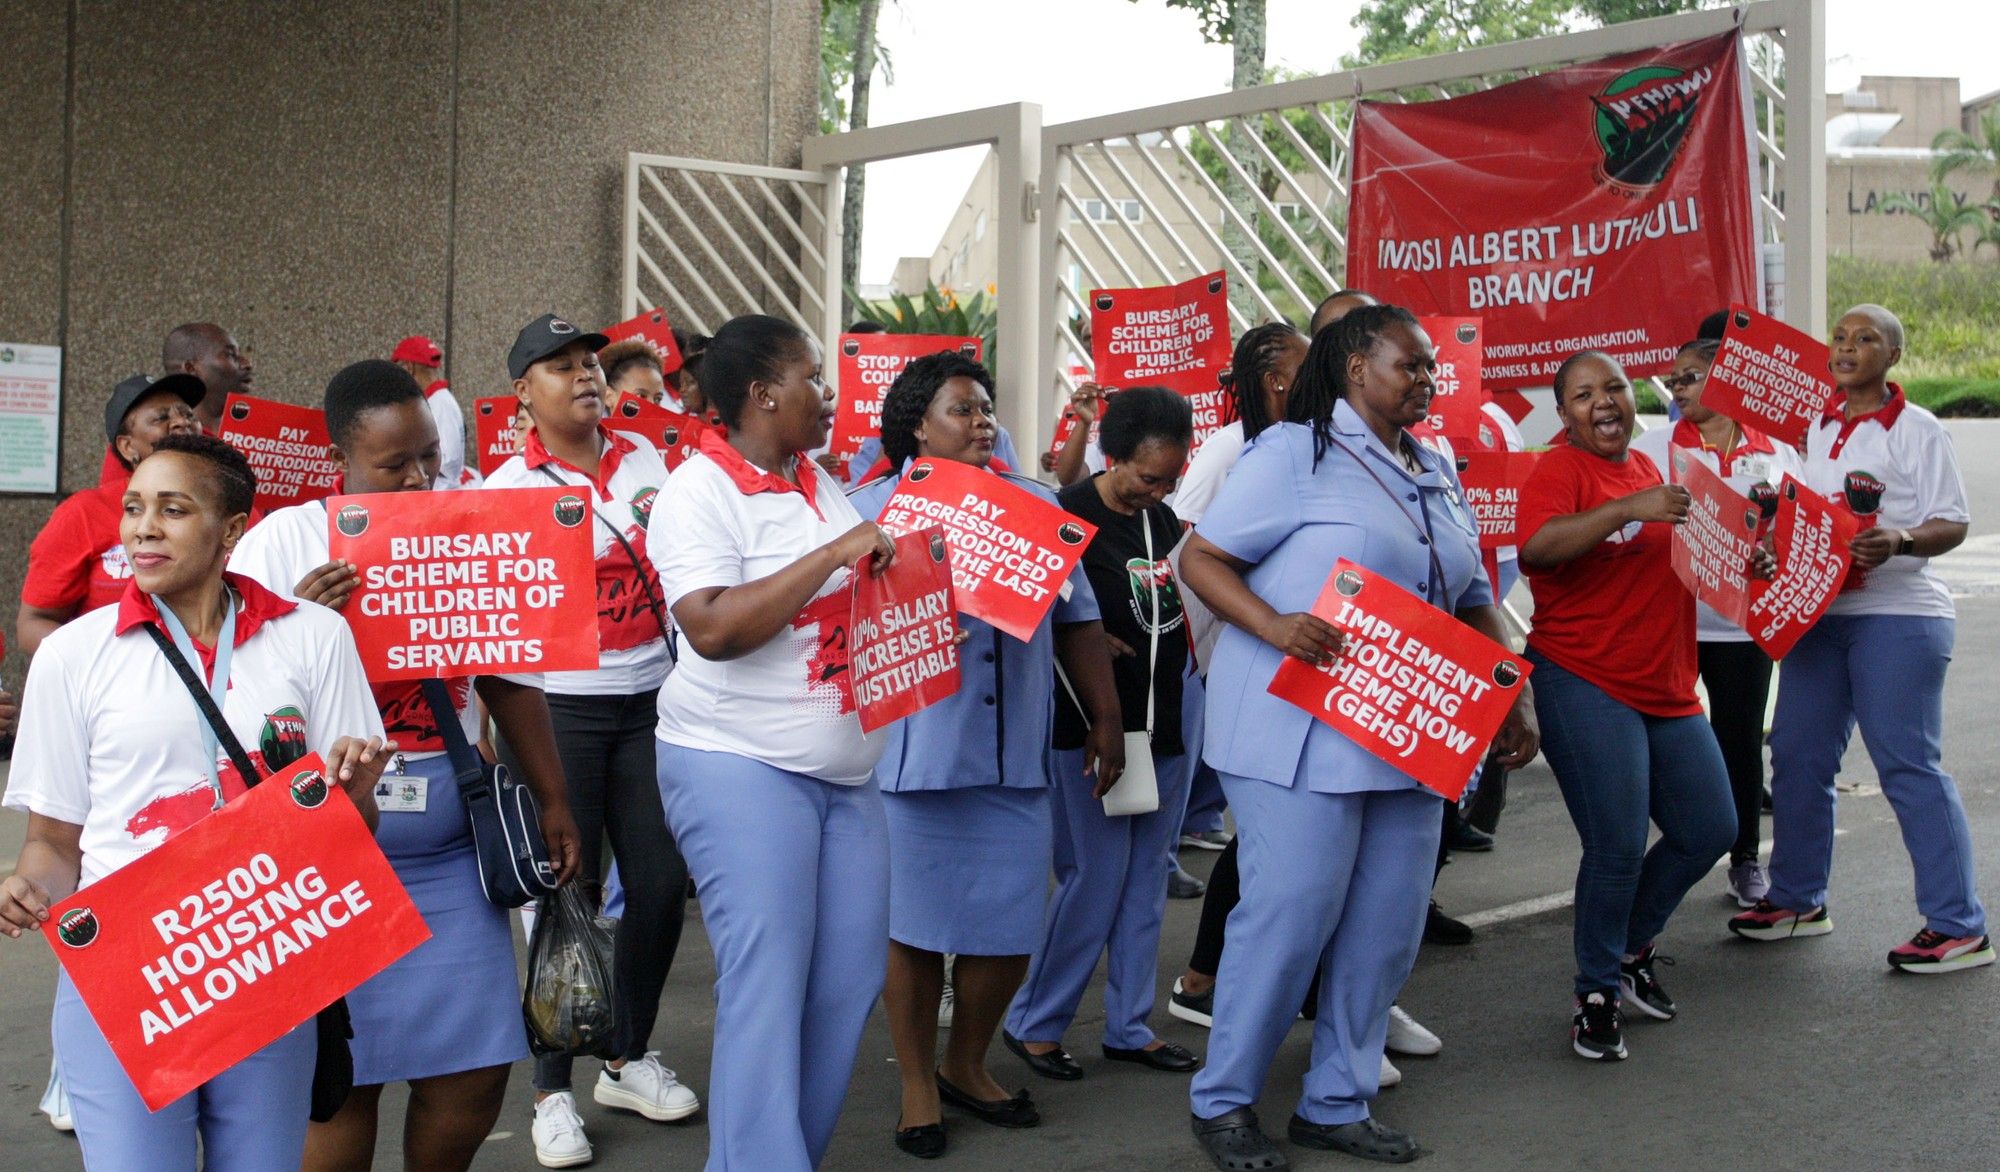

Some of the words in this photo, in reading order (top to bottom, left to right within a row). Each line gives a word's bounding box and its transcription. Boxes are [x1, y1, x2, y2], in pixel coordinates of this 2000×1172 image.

[1609, 65, 1712, 119] NEHAWU
[1449, 226, 1560, 268] ALBERT
[1571, 197, 1698, 257] LUTHULI
[1468, 266, 1594, 308] BRANCH
[1112, 323, 1179, 340] SCHEME
[1183, 313, 1210, 332] FOR
[1125, 302, 1198, 325] BURSARY
[1109, 333, 1191, 354] CHILDREN
[1195, 326, 1214, 342] OF
[1136, 347, 1193, 368] PUBLIC
[1485, 341, 1552, 359] WORKPLACE
[1554, 328, 1649, 353] ORGANISATION,
[1773, 344, 1800, 365] PAY
[857, 355, 900, 369] STOP
[1481, 363, 1528, 379] OUSNESS
[1531, 362, 1540, 376] &
[1724, 337, 1816, 391] PROGRESSION
[1818, 381, 1831, 398] TO
[1436, 380, 1459, 396] OF
[1712, 365, 1766, 398] BEYOND
[1769, 391, 1795, 412] THE
[1723, 353, 1742, 371] BE
[1743, 362, 1825, 411] INTRODUCED
[1741, 394, 1788, 424] NOTCH
[223, 431, 327, 459] PROGRESSION
[279, 426, 309, 442] PAY
[247, 451, 337, 473] INTRODUCED
[279, 470, 305, 485] THE
[961, 493, 1006, 521] PAY
[1466, 487, 1491, 503] 0%
[1704, 493, 1720, 519] PAY
[883, 509, 911, 526] BE
[888, 493, 1033, 556] PROGRESSION
[1036, 546, 1064, 571] TO
[1689, 500, 1734, 545] OGRESSION
[1737, 538, 1751, 559] TO
[390, 532, 532, 561] BURSARY
[1688, 517, 1746, 573] INTRODUCED
[1750, 502, 1807, 616] IMPLEMENT
[366, 561, 489, 589] SCHEME
[497, 558, 558, 583] FOR
[951, 548, 994, 577] THE
[993, 568, 1050, 603] LAST
[1690, 555, 1720, 591] NOTCH
[1704, 549, 1721, 572] THE
[1724, 565, 1748, 592] LAST
[1761, 566, 1823, 642] SCHEME
[1816, 510, 1834, 566] NOW
[1767, 523, 1819, 616] HOUSING
[1797, 553, 1843, 624] (GEHS)
[360, 587, 516, 616] CHILDREN
[525, 585, 565, 608] OF
[853, 617, 878, 652] 10%
[881, 588, 948, 635] SALARY
[409, 614, 519, 641] PUBLIC
[387, 639, 543, 670] SERVANTS
[854, 625, 933, 680] INCREASE
[934, 616, 954, 645] IS
[1334, 601, 1491, 703] IMPLEMENT
[1341, 632, 1462, 718] HOUSING
[1324, 686, 1418, 757] (GEHS)
[1406, 703, 1477, 755] NOW
[151, 852, 279, 945] R2500
[140, 866, 328, 996] HOUSING
[139, 880, 373, 1046] ALLOWANCE
